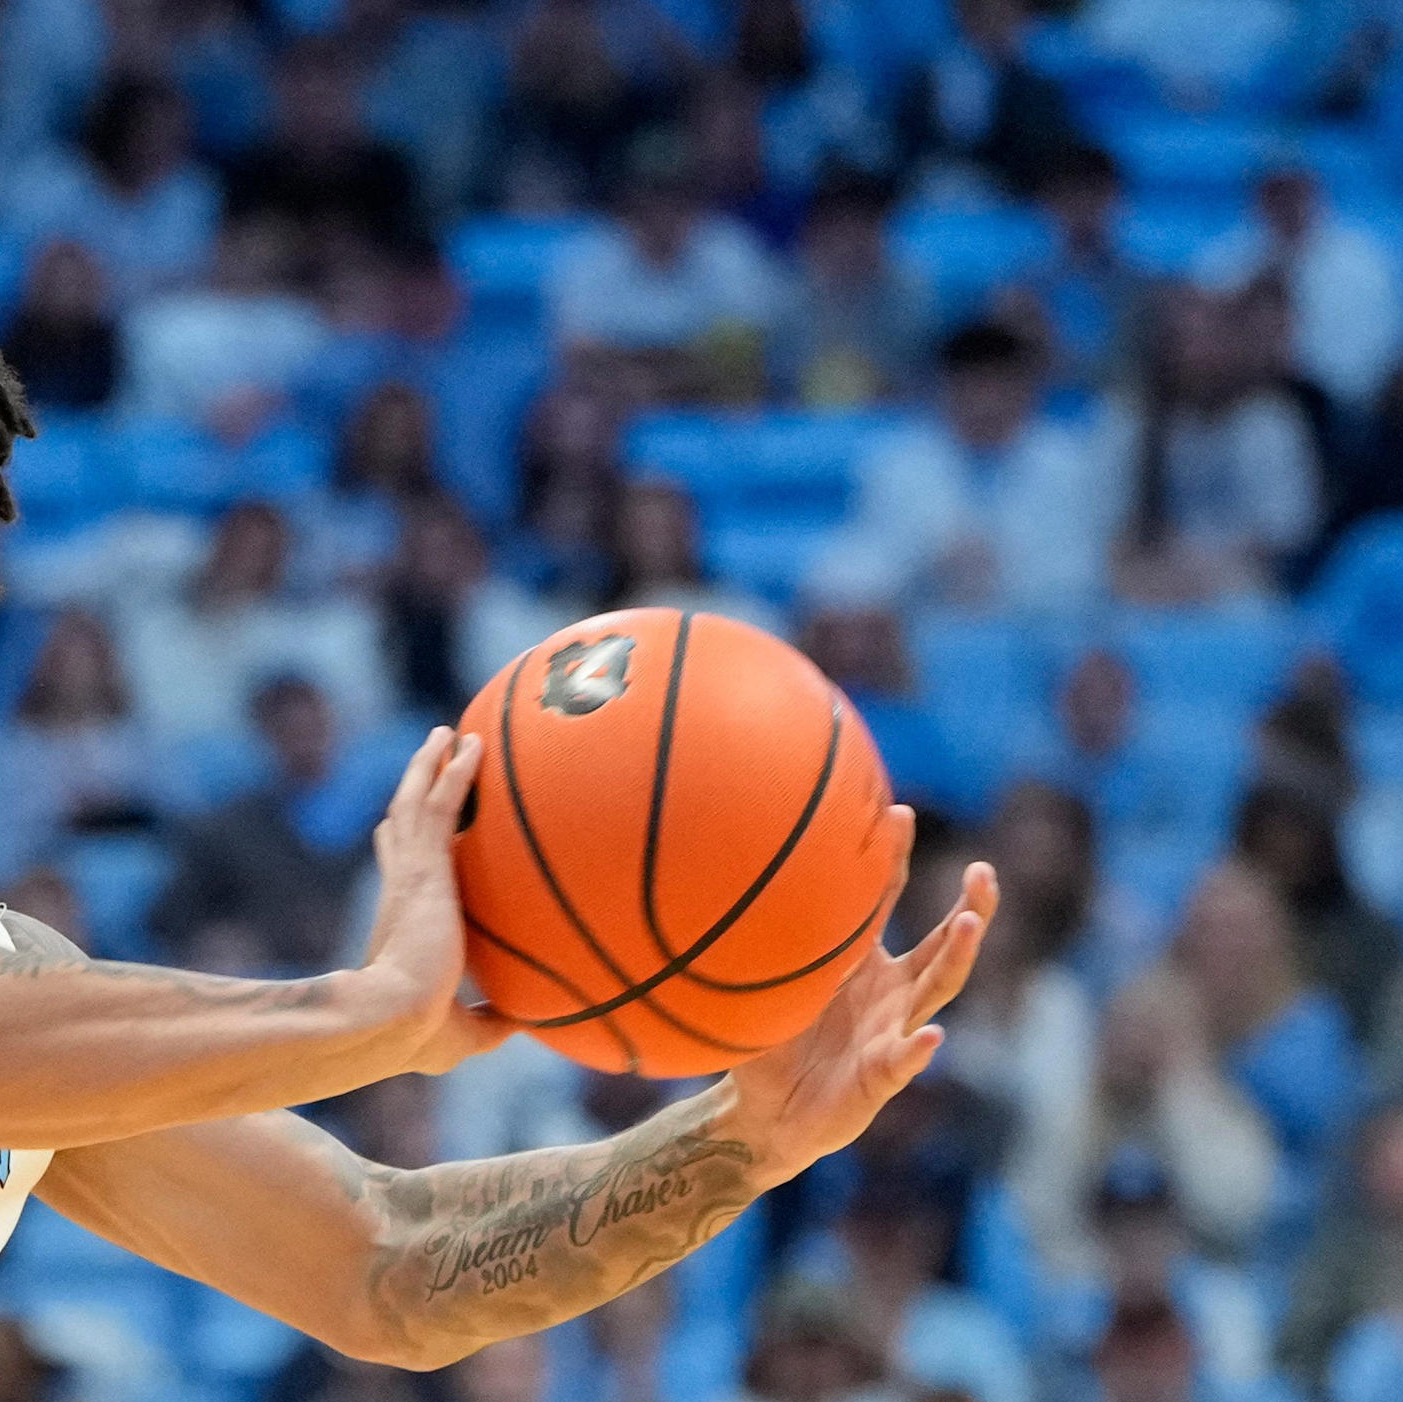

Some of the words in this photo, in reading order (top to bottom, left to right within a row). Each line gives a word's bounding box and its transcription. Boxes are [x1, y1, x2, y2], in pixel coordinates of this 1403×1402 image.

[424, 1225, 549, 1302] Dream
[568, 1163, 694, 1247] Chaser
[482, 1255, 539, 1295] 2004
